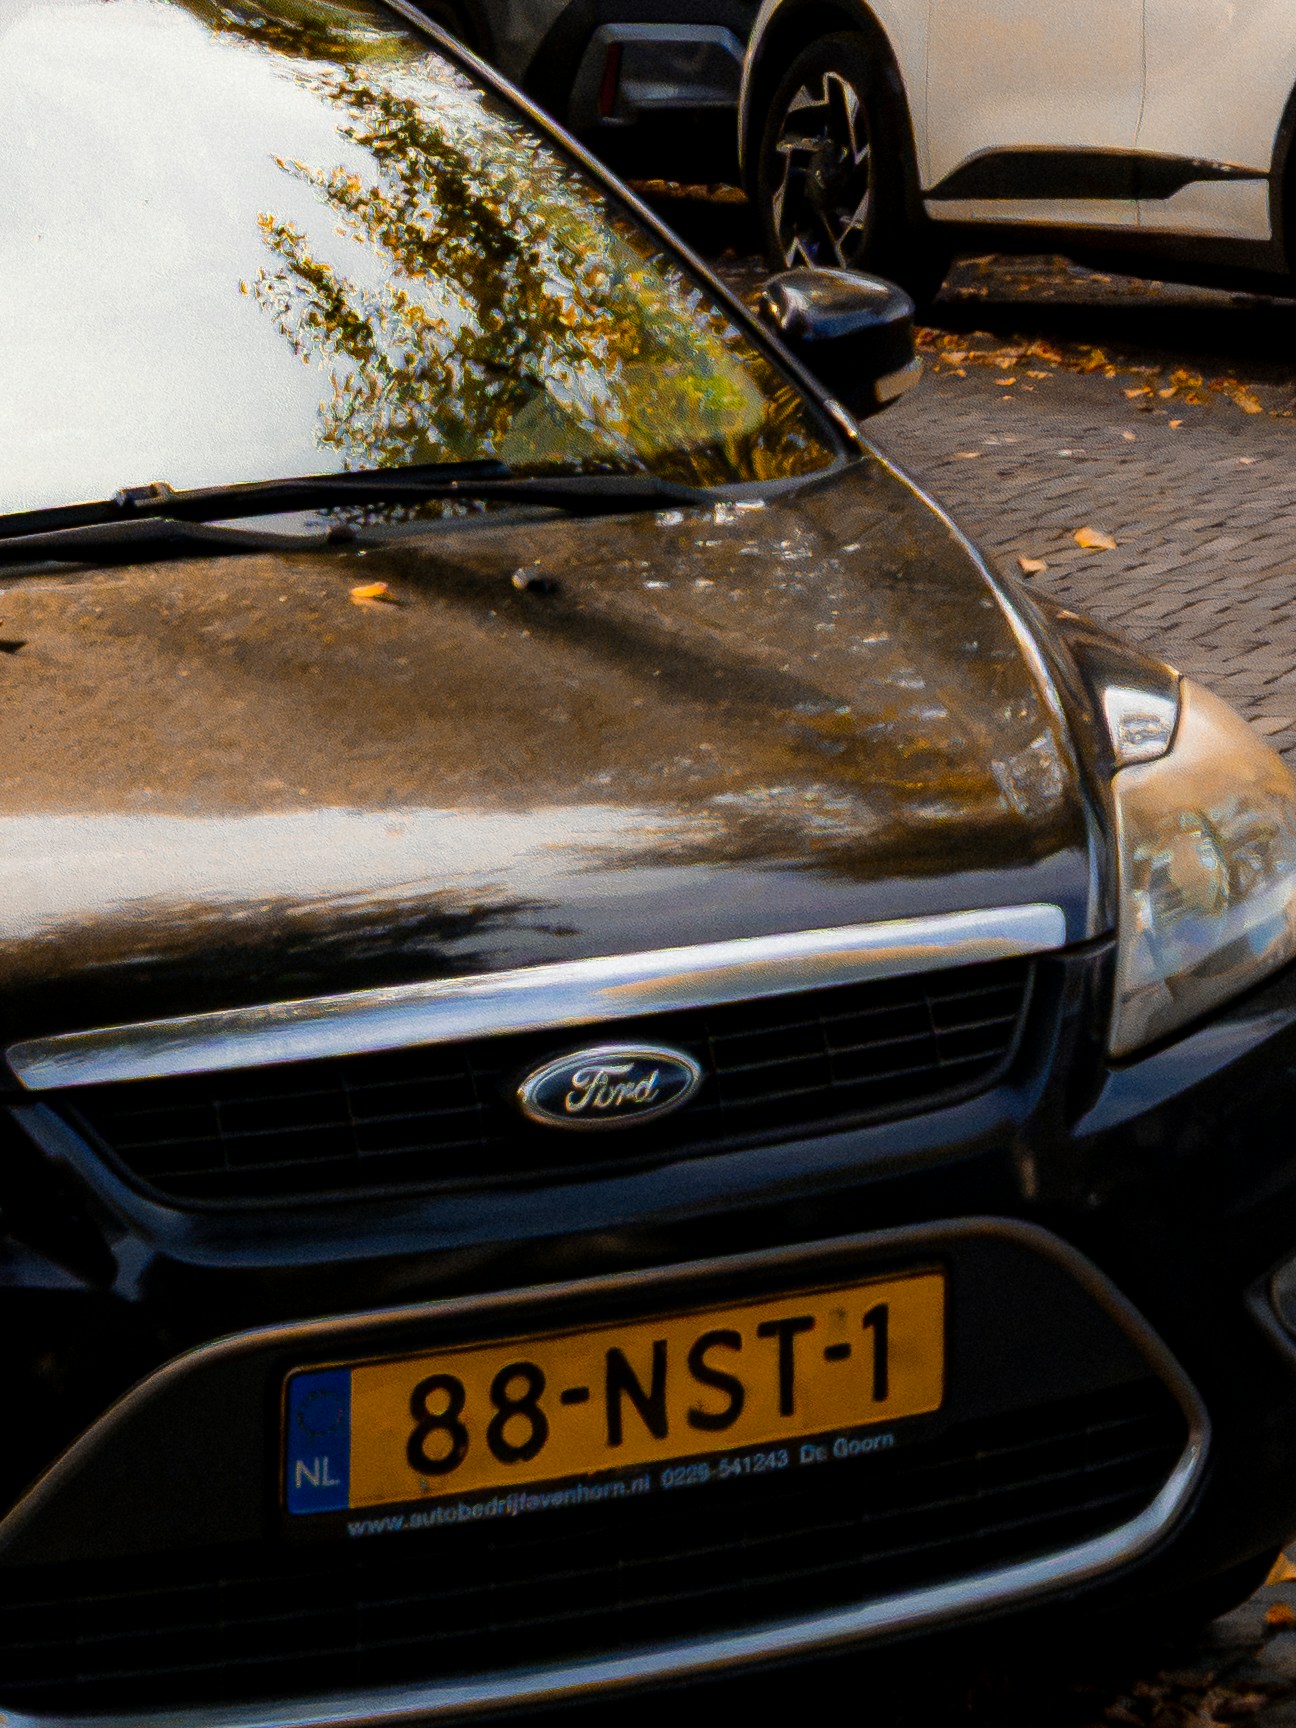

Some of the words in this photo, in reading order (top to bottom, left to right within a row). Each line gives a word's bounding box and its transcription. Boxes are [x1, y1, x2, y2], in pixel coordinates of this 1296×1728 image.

[565, 1062, 661, 1114] Ford
[405, 1302, 890, 1476] 88-NST-1
[799, 1444, 828, 1466] De
[832, 1432, 896, 1458] Goorn
[294, 1455, 341, 1489] NL
